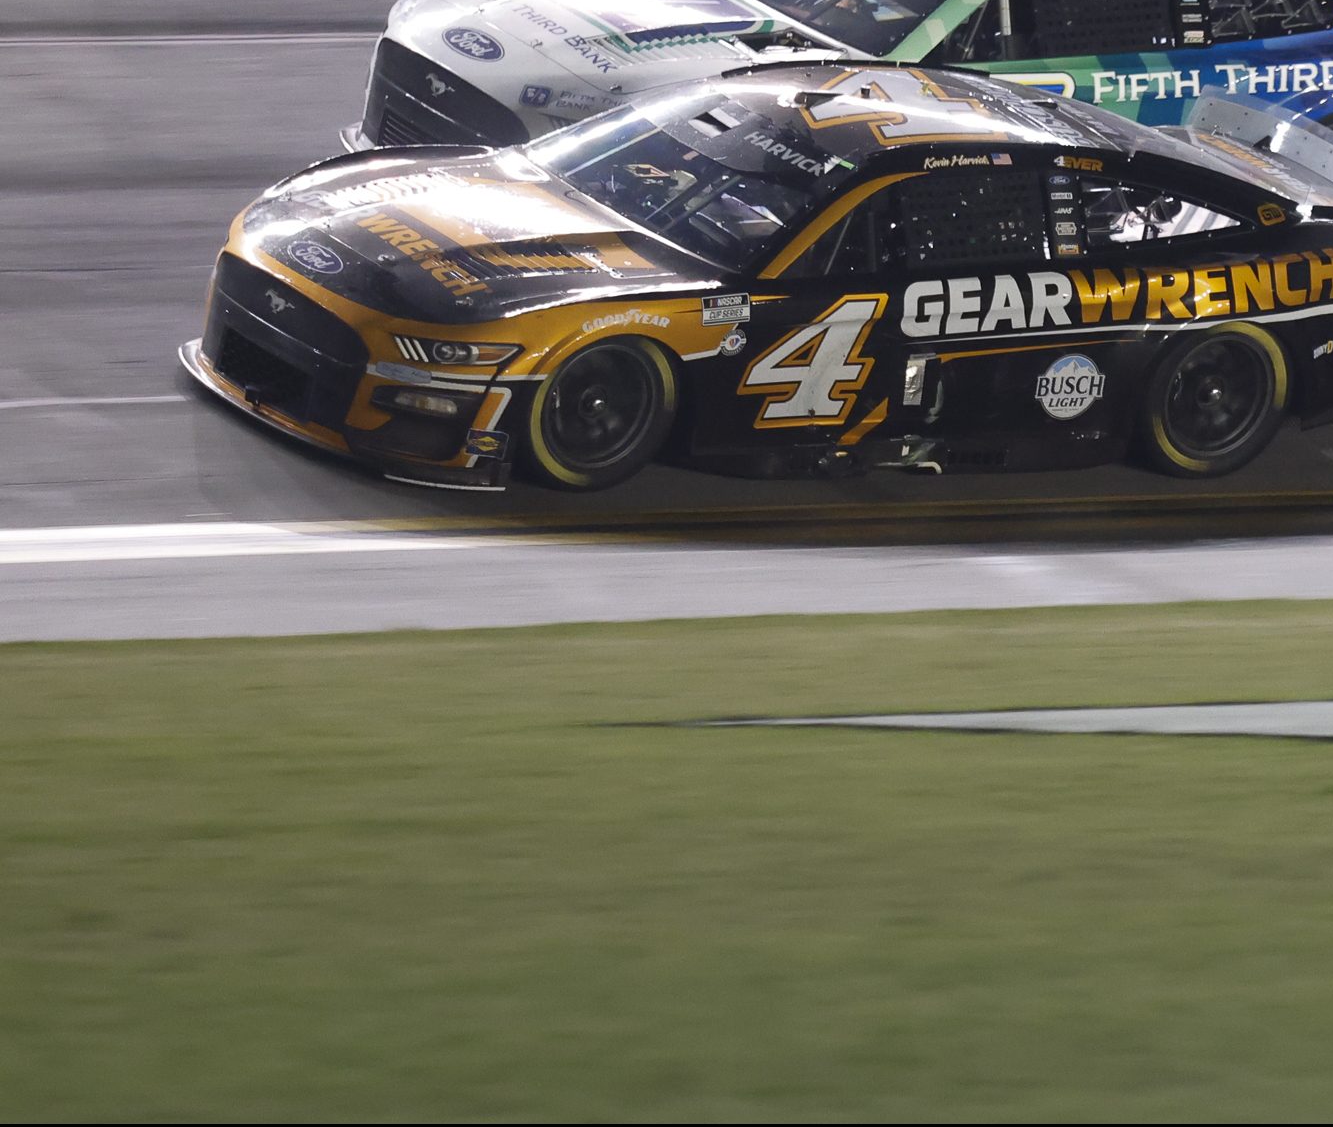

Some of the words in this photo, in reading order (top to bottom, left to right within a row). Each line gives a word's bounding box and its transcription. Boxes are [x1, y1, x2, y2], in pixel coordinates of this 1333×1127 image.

[448, 28, 494, 58] Ford
[511, 4, 568, 37] THIRD
[563, 34, 618, 74] BANK
[1093, 68, 1201, 104] FIFTH
[743, 130, 825, 177] HARVICK
[923, 155, 950, 170] Kevin
[1053, 155, 1104, 172] 4EVER
[356, 212, 489, 297] WRENCH
[582, 308, 671, 334] GOODYEAR
[708, 311, 725, 319] CUP
[723, 308, 743, 318] SERIES
[737, 294, 888, 429] 4
[1036, 375, 1104, 397] BUSCH
[1047, 396, 1087, 408] LIGHT
